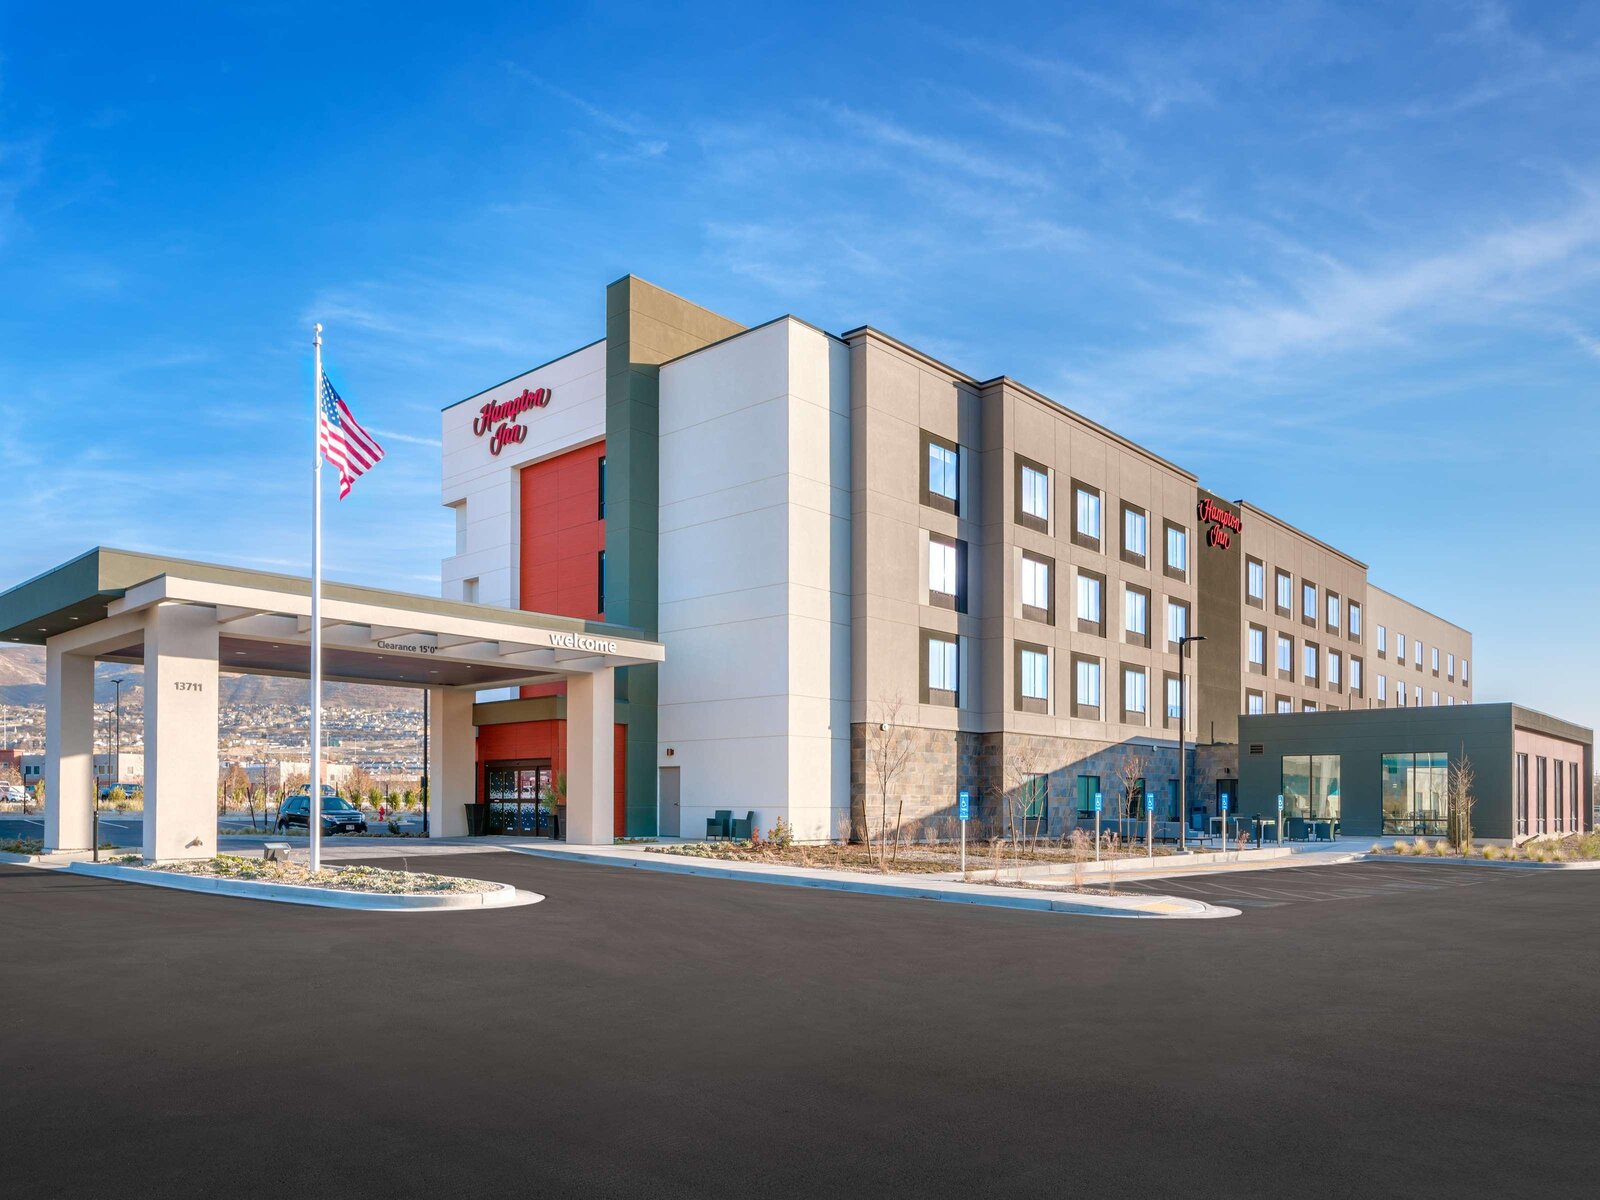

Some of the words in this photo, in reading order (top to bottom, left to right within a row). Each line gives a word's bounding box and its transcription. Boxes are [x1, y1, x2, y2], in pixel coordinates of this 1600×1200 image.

[473, 388, 551, 436] Hampton
[490, 423, 527, 456] Inn
[1198, 498, 1242, 534] Hampton
[1210, 524, 1231, 549] Inn
[377, 640, 417, 652] Clearance
[549, 633, 617, 653] welcome
[174, 681, 203, 692] 13711
